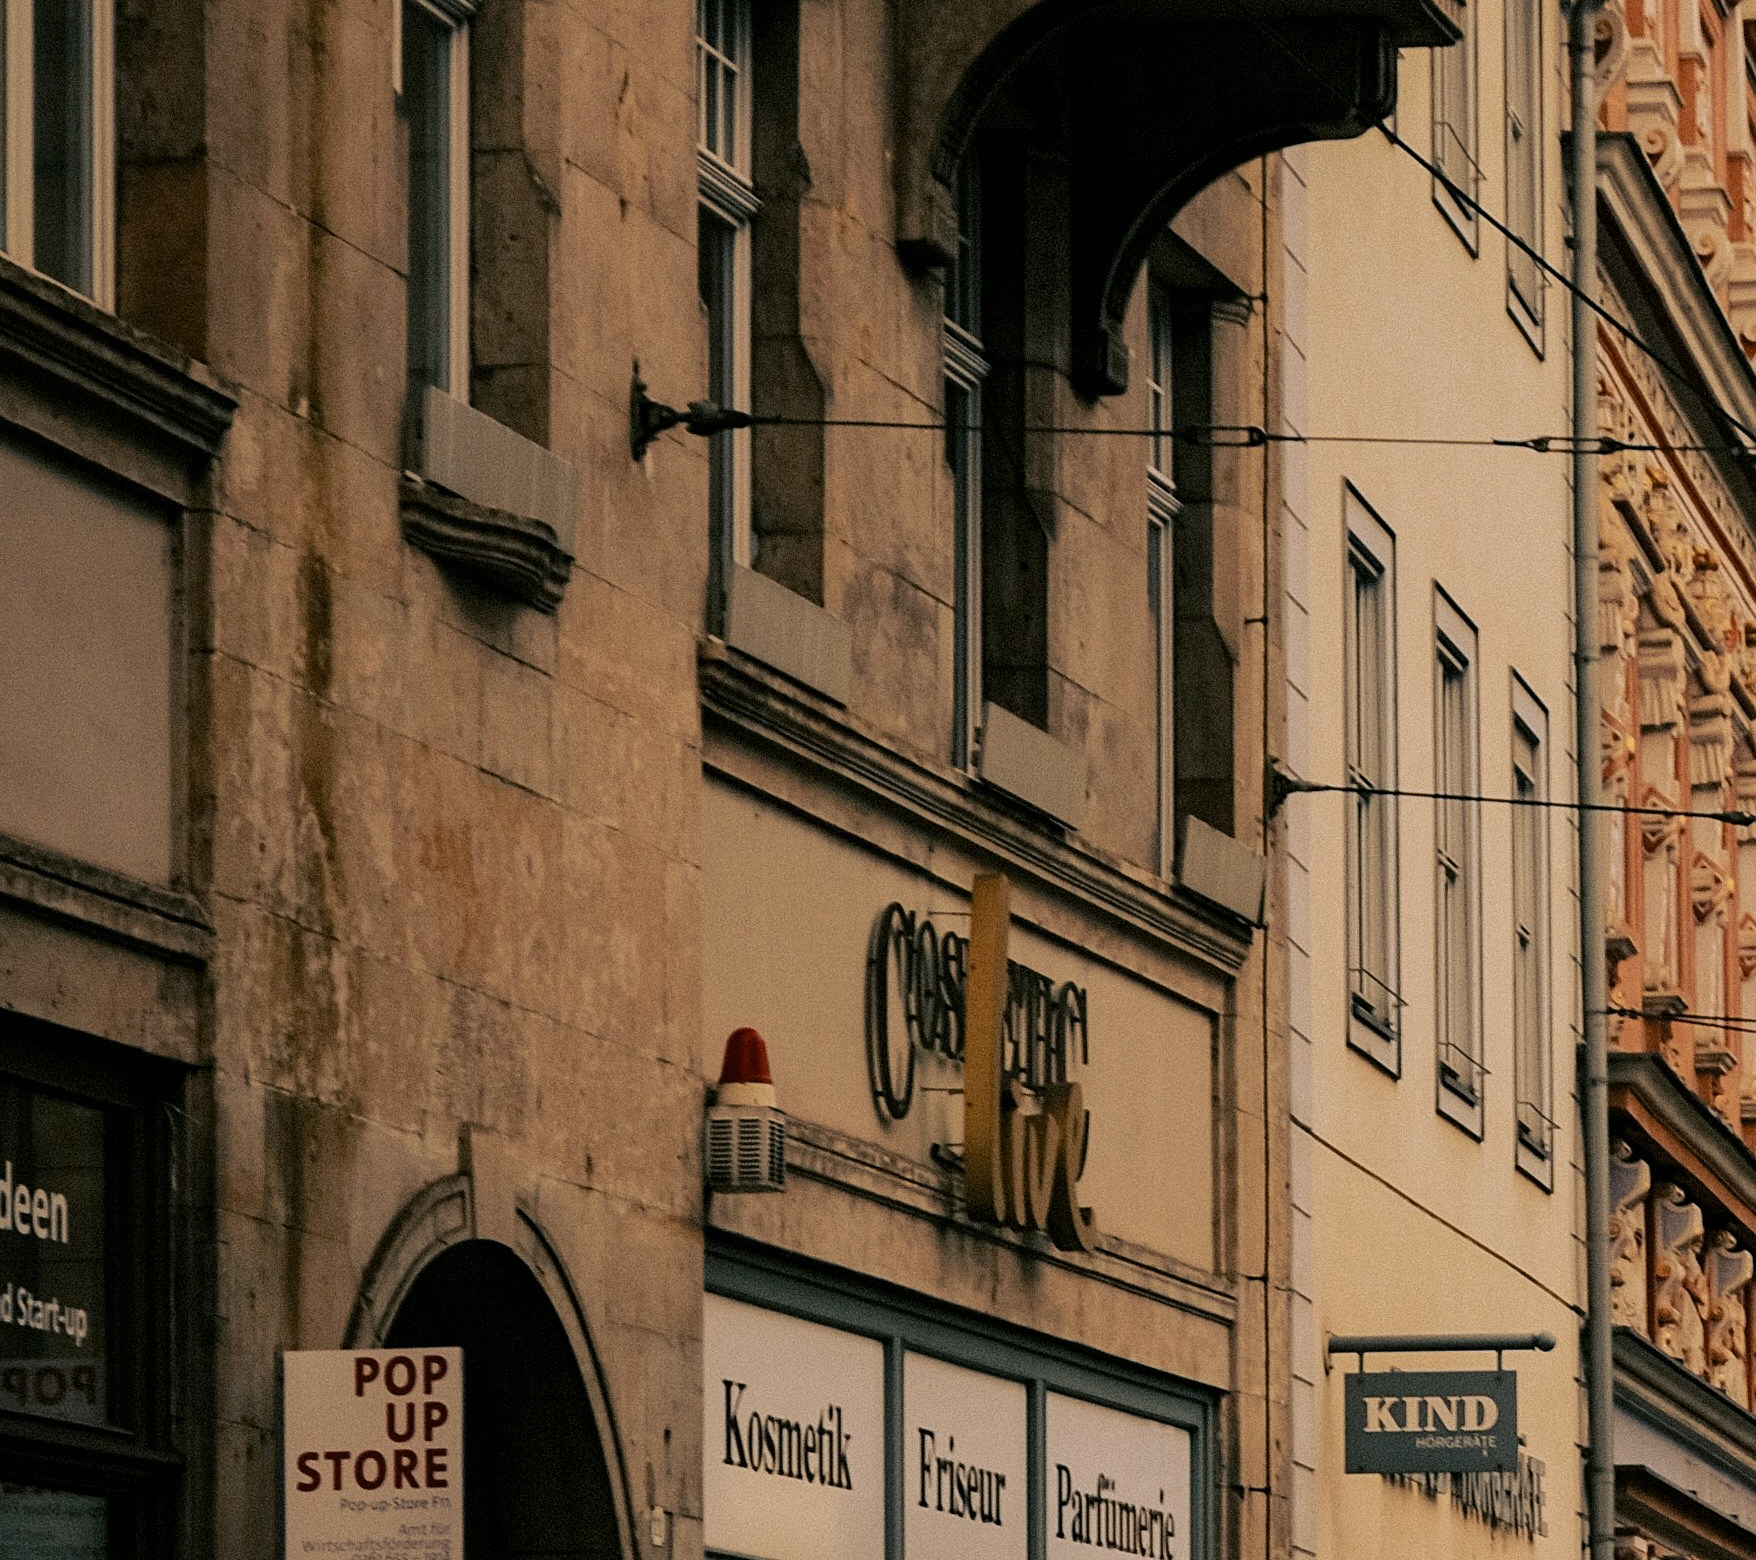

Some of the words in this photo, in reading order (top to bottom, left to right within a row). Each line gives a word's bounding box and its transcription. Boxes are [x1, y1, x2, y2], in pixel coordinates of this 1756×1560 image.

[16, 1286, 89, 1348] Start-up
[355, 1355, 448, 1397] POP
[386, 1402, 448, 1443] UP
[722, 1379, 853, 1491] Kosmetik
[1362, 1395, 1500, 1433] KIND
[1415, 1434, 1497, 1449] HÖRGERÄTE
[296, 1448, 449, 1492] STORE
[917, 1427, 1007, 1527] Friseur
